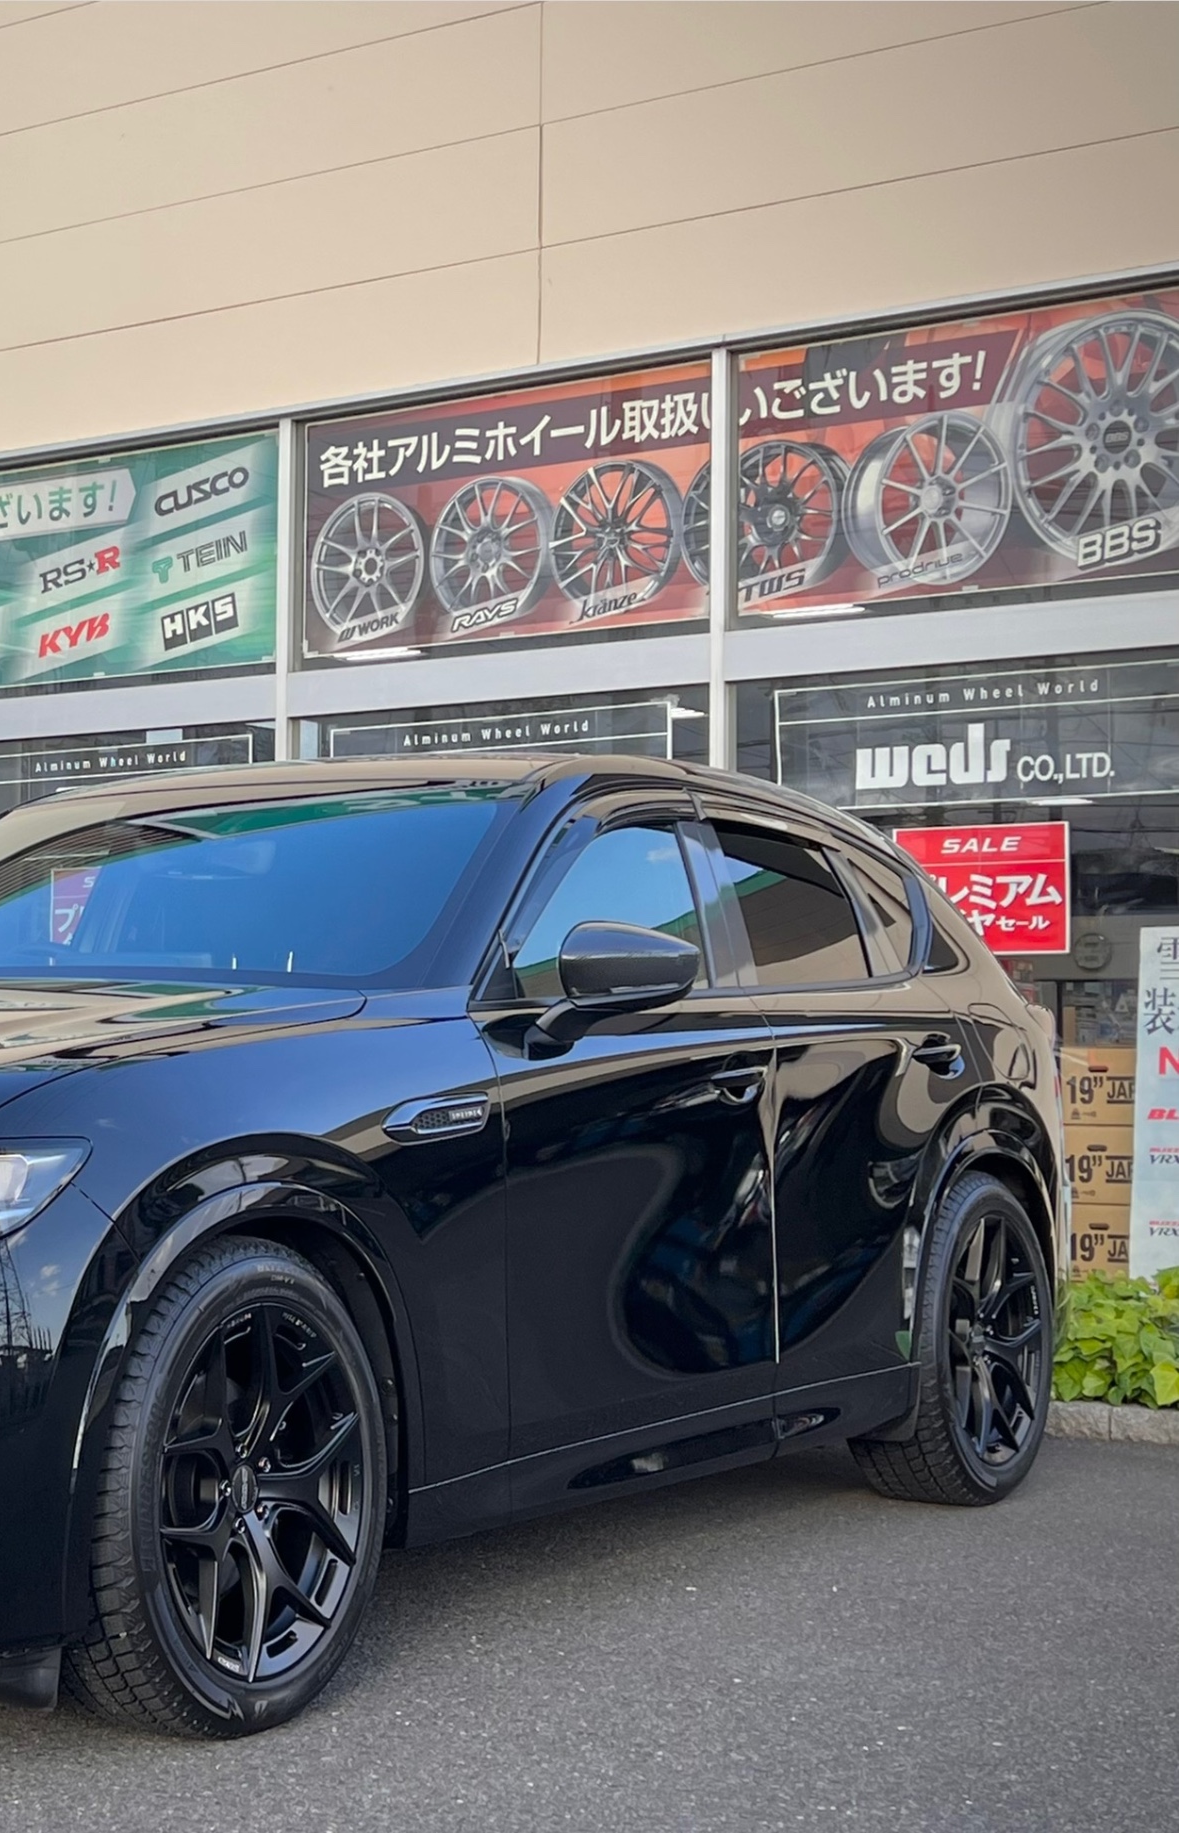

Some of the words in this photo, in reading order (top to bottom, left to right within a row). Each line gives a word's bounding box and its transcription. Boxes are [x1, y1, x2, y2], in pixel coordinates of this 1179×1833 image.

[154, 466, 250, 517] CUSCO
[176, 530, 248, 573] TEIN
[1077, 516, 1162, 571] BBS
[877, 551, 964, 589] prodrive
[163, 596, 235, 640] HKS
[358, 611, 399, 637] WORK
[451, 598, 520, 633] RAYS
[38, 612, 110, 658] KYB
[867, 690, 951, 708] Alminum
[962, 684, 1024, 700] Wheel
[1037, 679, 1099, 695] World
[403, 731, 472, 747] Alminum
[480, 728, 531, 741] Wheel
[540, 719, 590, 736] World
[35, 760, 92, 773] Alminum
[99, 755, 139, 768] Wheel
[147, 750, 187, 764] World
[856, 722, 1011, 790] weds
[1016, 751, 1116, 784] CO.,LTD.
[940, 836, 1022, 854] SALE
[929, 873, 1063, 910] レミアム
[960, 909, 1051, 937] ヤセール
